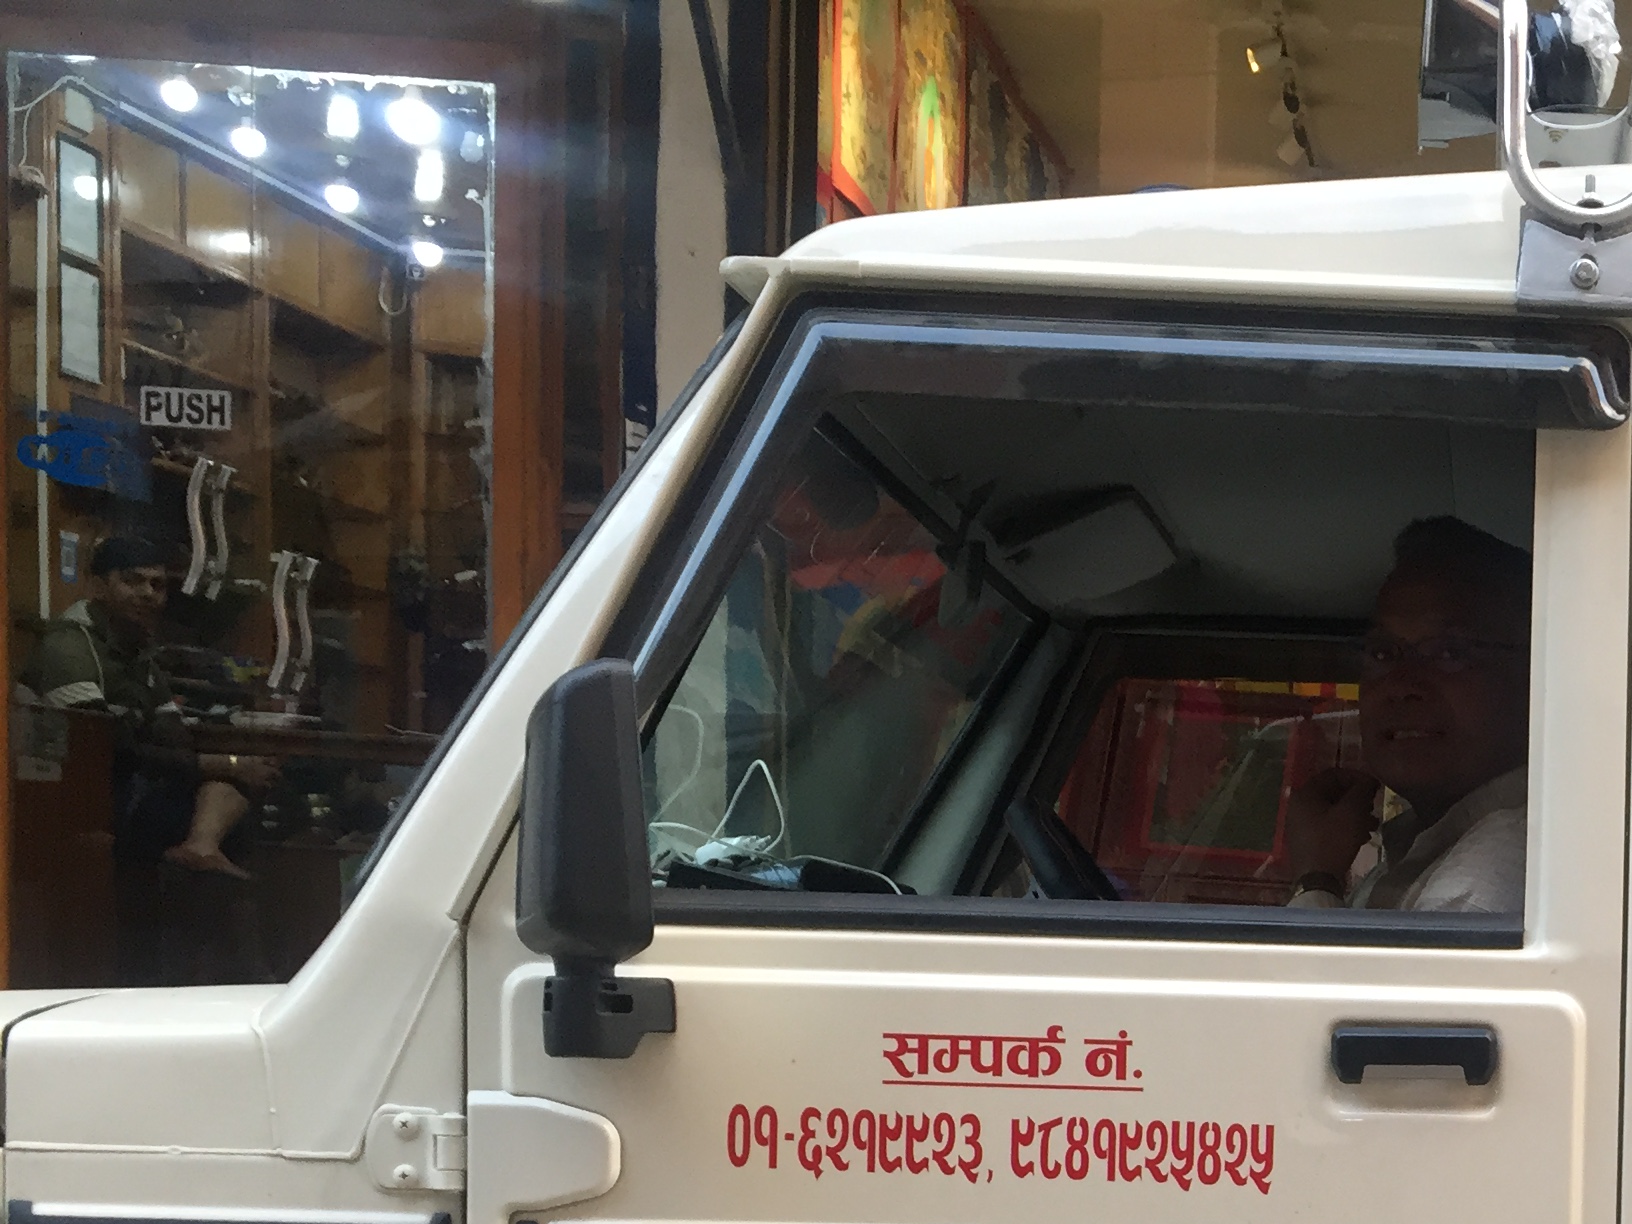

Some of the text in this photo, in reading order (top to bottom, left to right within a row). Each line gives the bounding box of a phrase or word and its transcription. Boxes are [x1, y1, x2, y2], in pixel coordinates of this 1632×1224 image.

[145, 390, 226, 426] PUSH
[882, 1024, 1144, 1080] सम्पर्क नं.
[727, 1103, 1276, 1196] ०१-६२१९९२३, ९८४१९२५४२५
